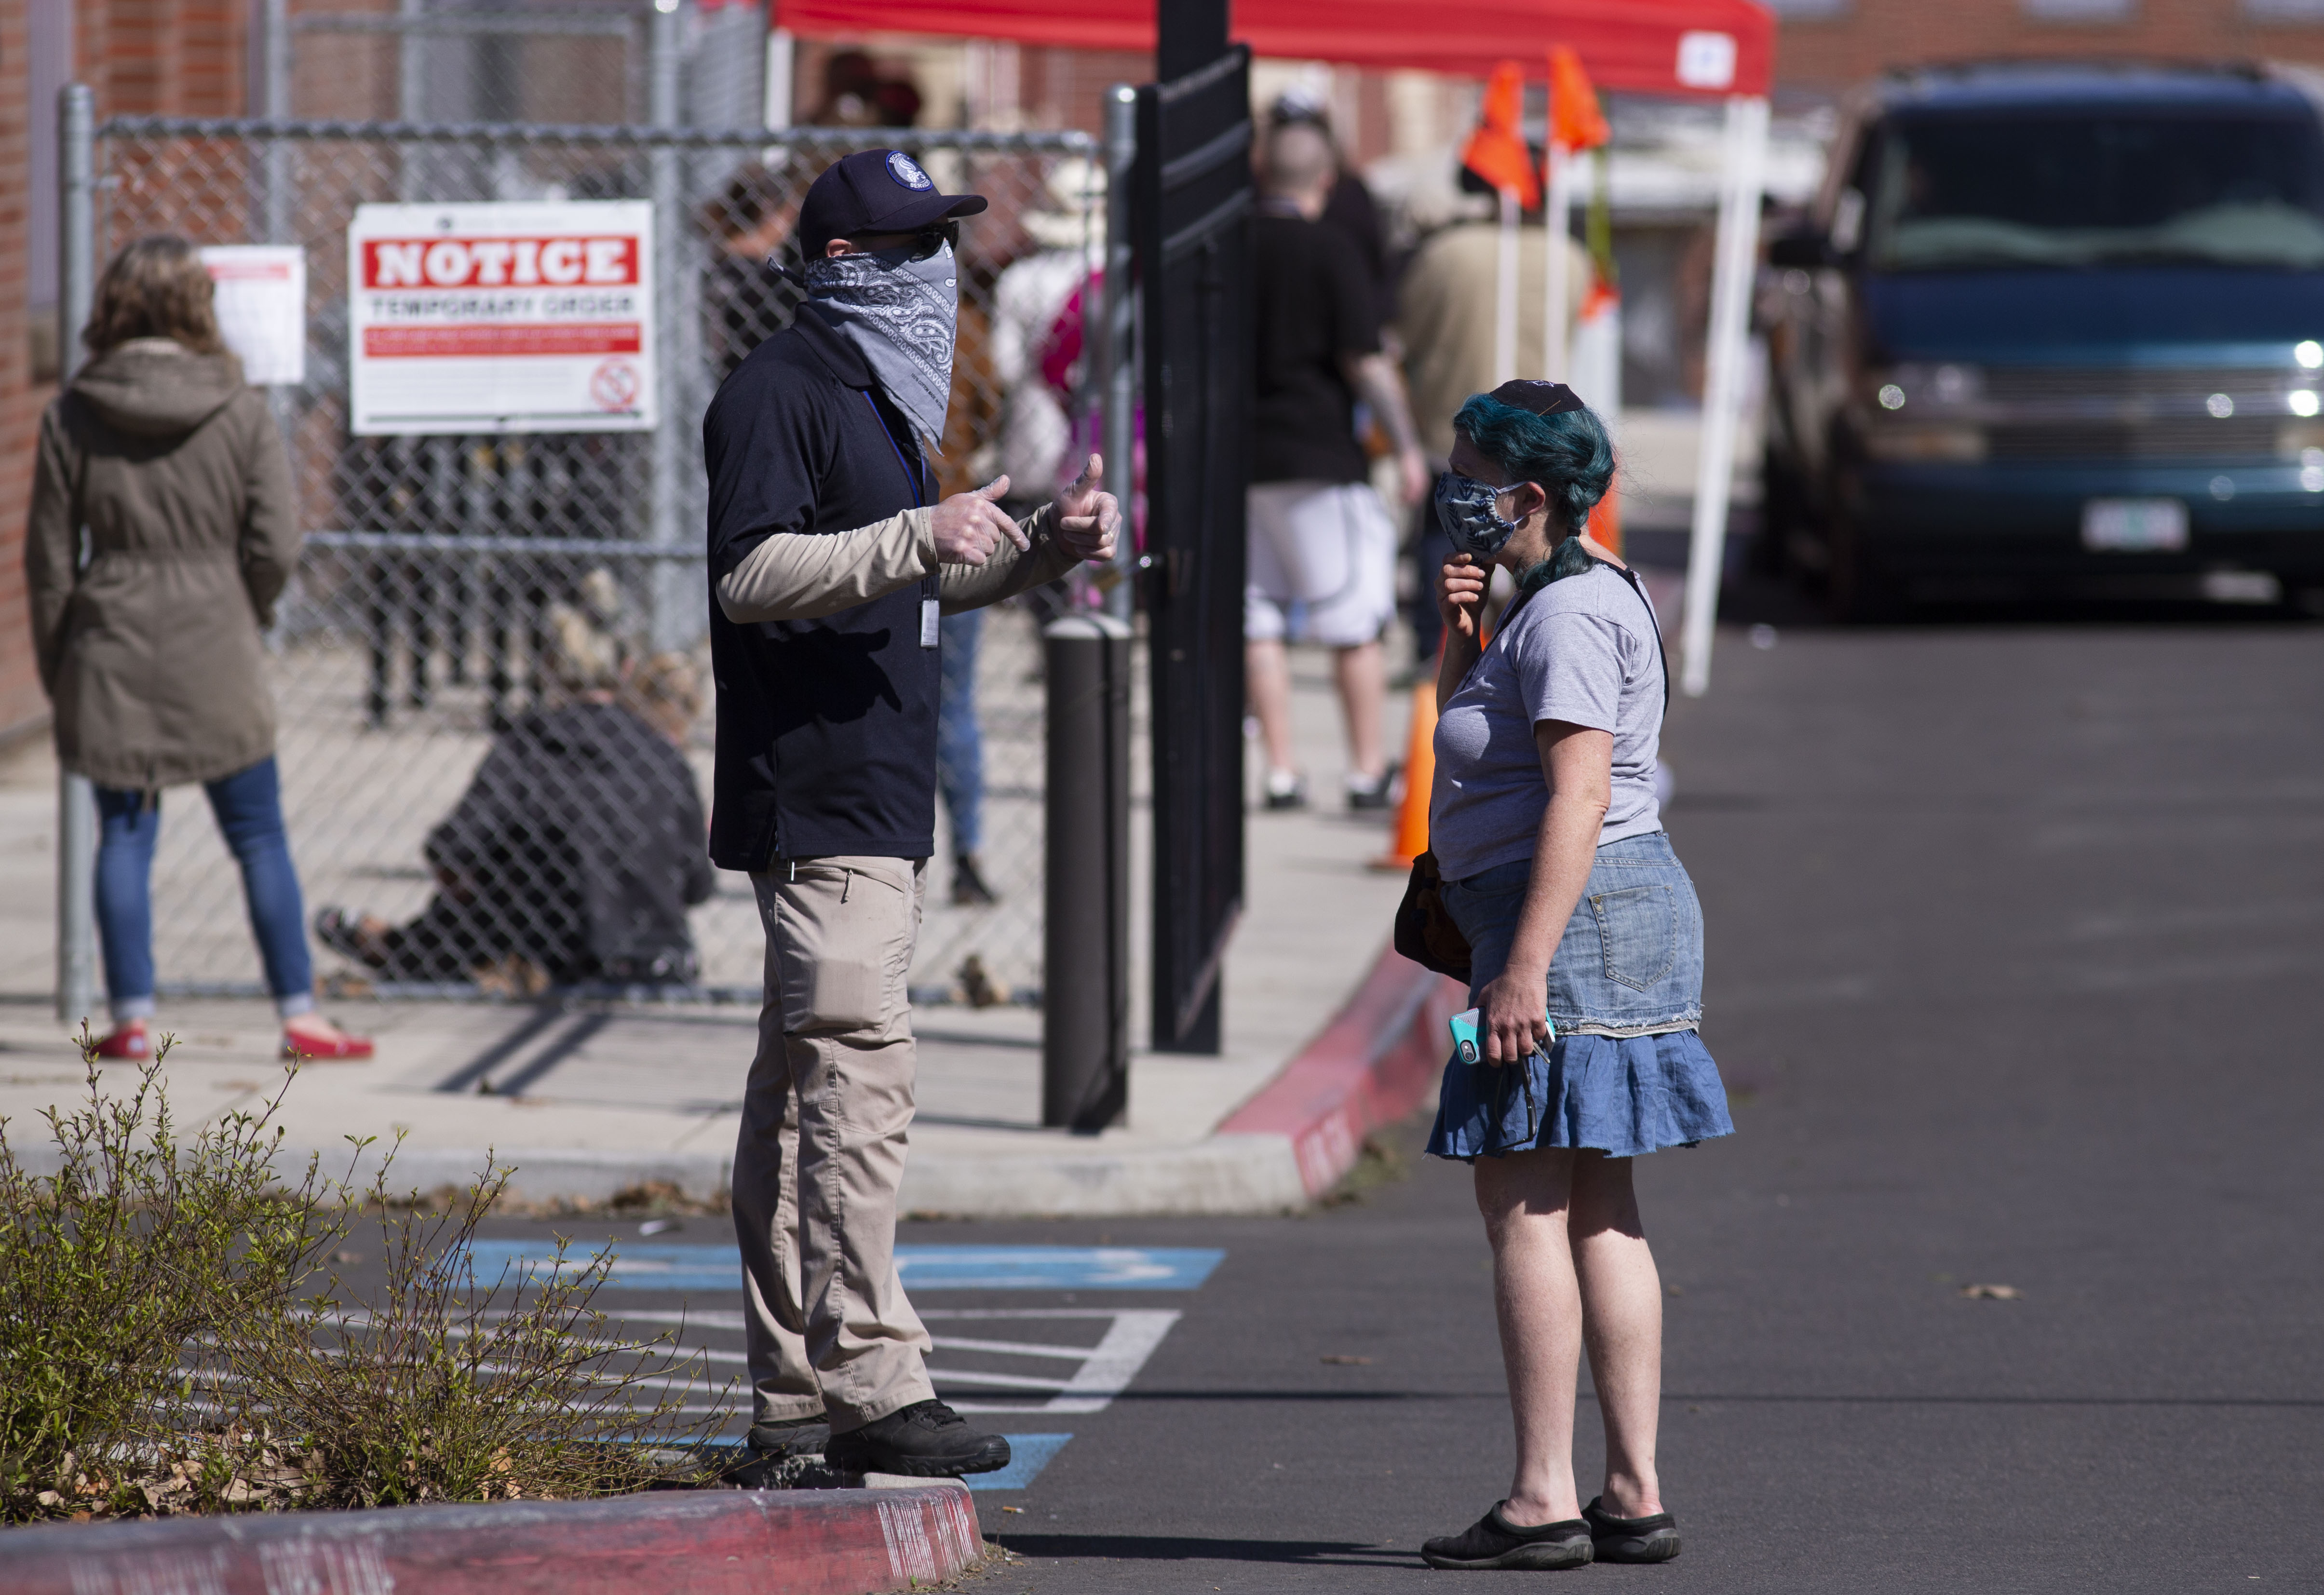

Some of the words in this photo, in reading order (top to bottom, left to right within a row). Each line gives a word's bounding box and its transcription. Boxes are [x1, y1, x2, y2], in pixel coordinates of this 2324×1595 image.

[374, 240, 626, 286] NOTICE
[371, 295, 534, 318] TEMPORARY
[542, 294, 635, 317] ORDER
[911, 373, 919, 382] 100%
[918, 380, 929, 392] COTTON
